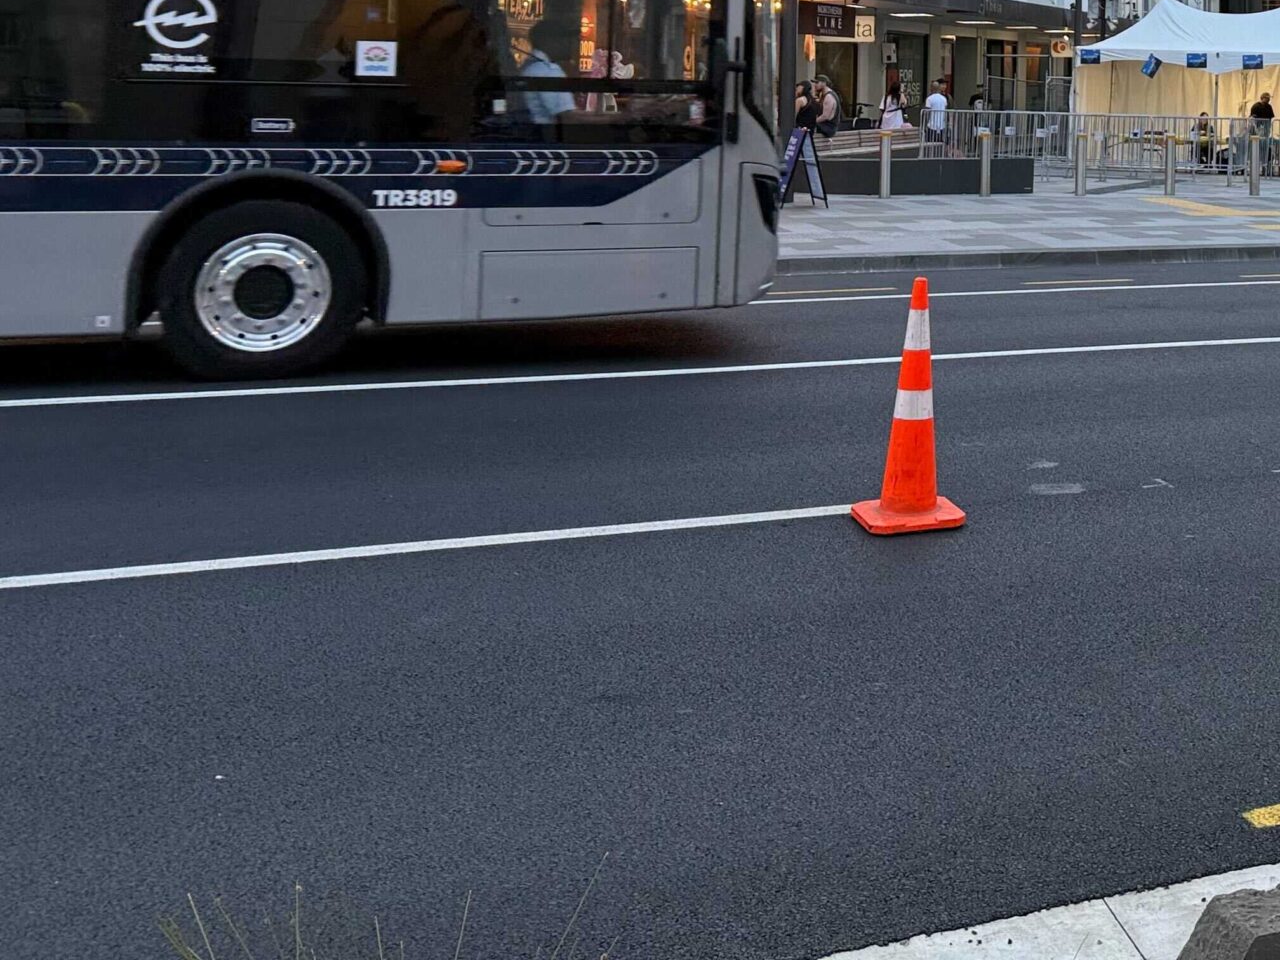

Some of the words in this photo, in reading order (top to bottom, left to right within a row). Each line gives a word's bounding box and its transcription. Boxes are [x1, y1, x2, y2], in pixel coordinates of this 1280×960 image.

[816, 16, 842, 29] LINE
[856, 20, 873, 38] ta
[899, 69, 913, 82] FOR
[901, 83, 921, 95] EASE
[372, 189, 458, 207] TR3819
